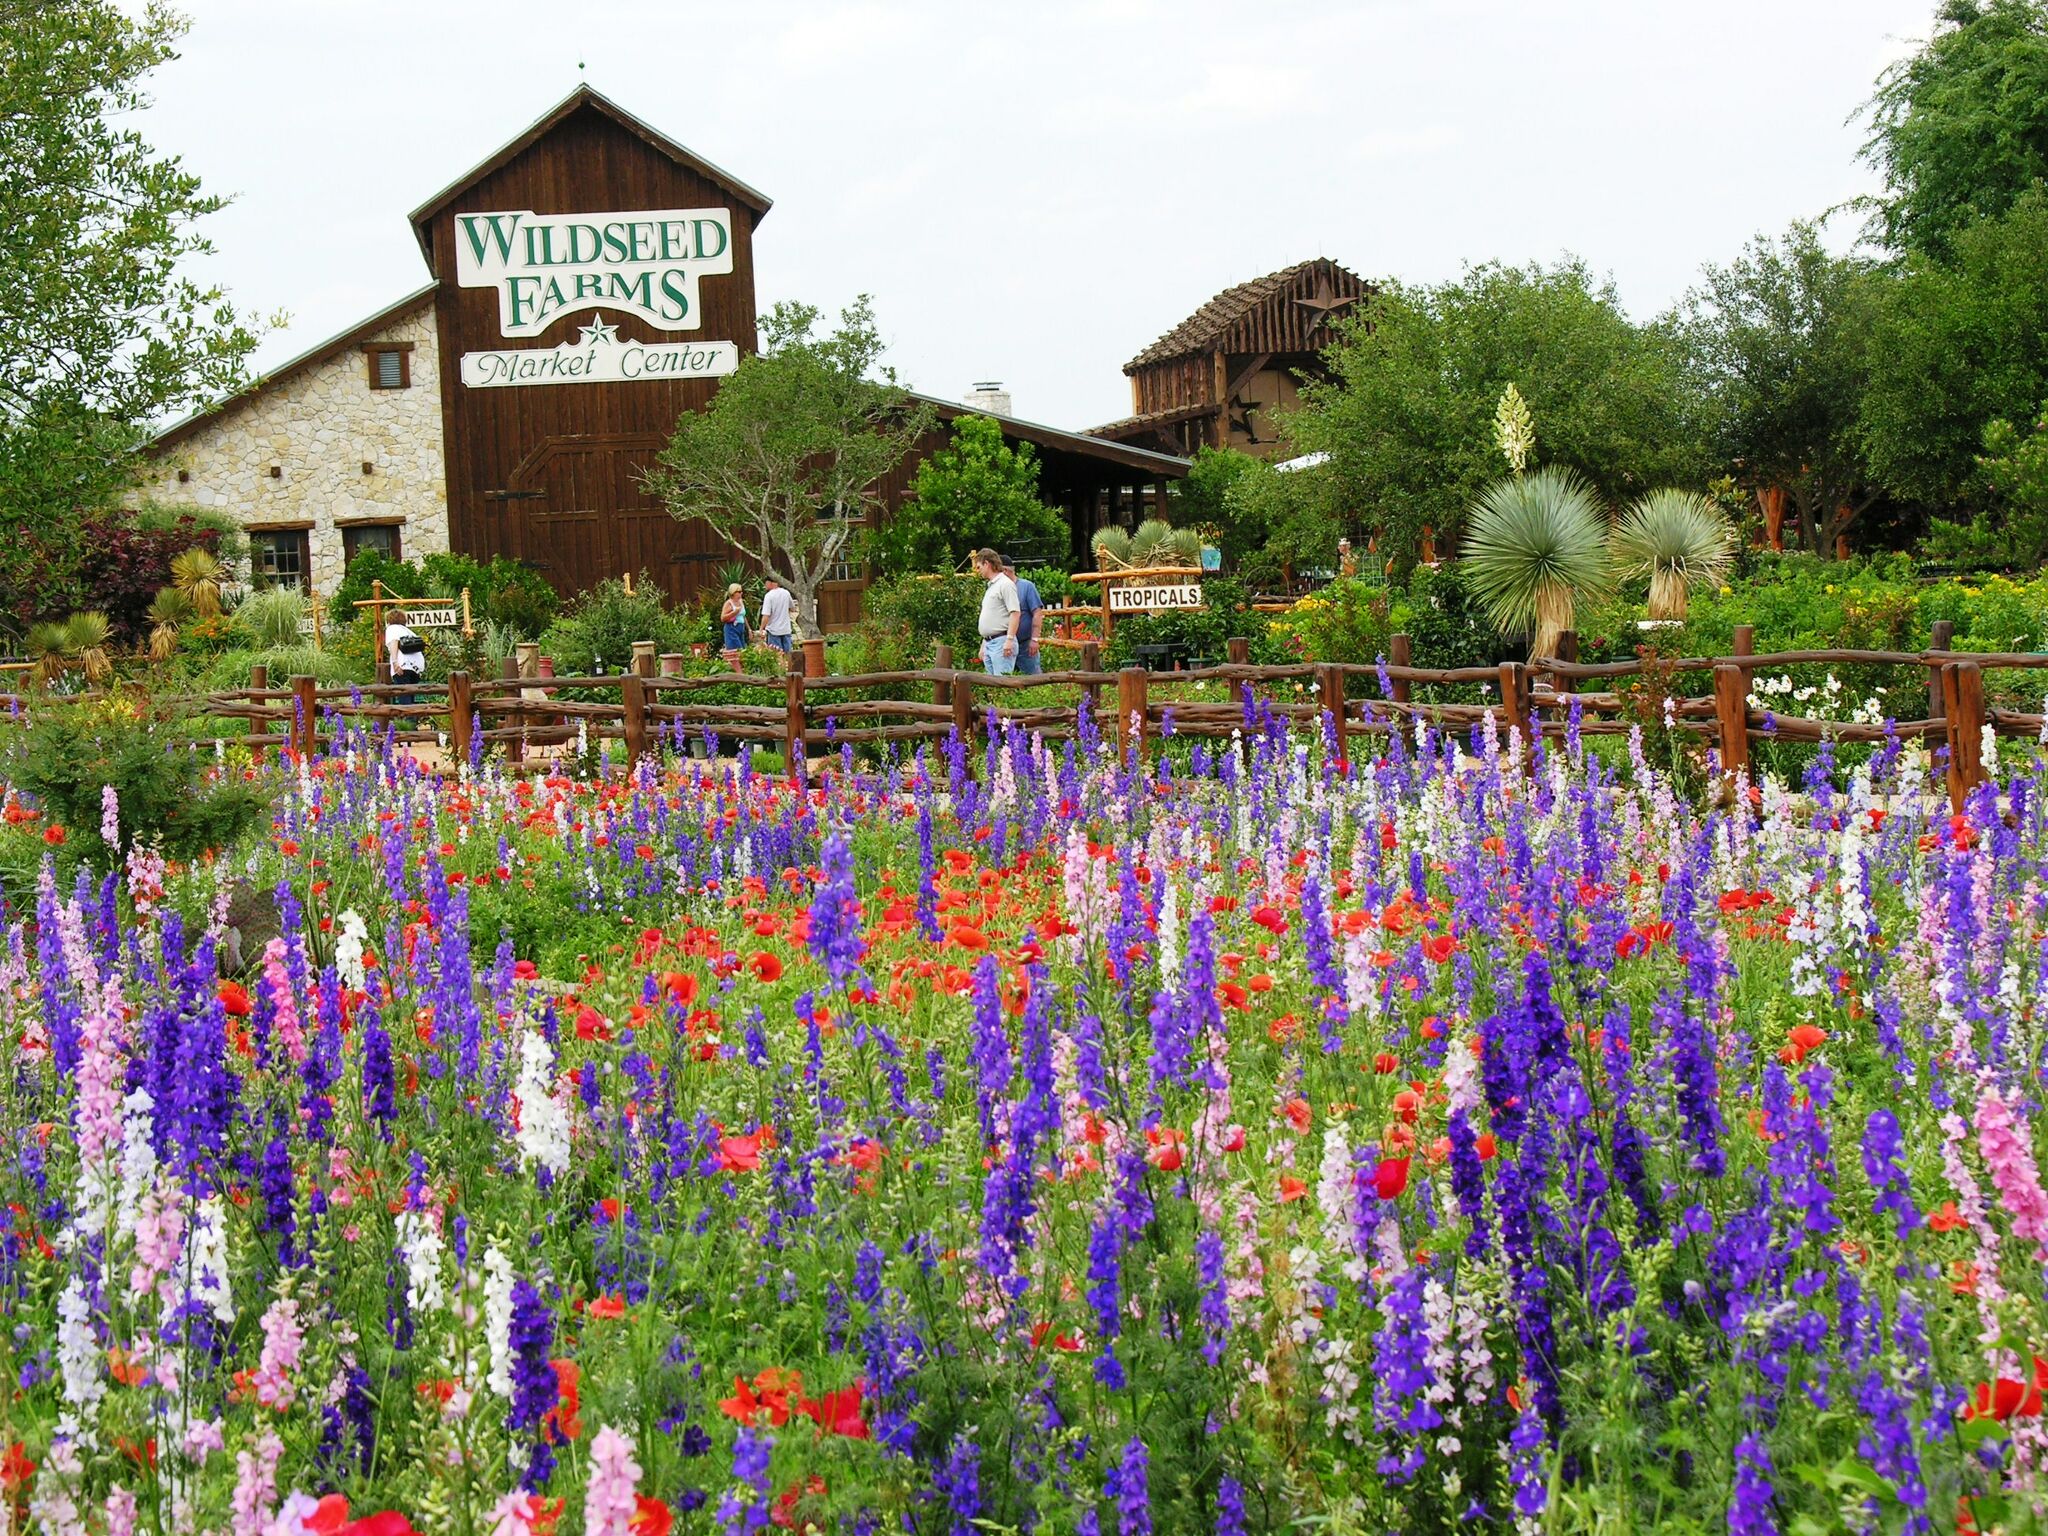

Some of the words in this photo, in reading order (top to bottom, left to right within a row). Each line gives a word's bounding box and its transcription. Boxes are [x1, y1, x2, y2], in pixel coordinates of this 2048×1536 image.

[457, 214, 727, 268] WILDSEED
[505, 269, 688, 328] FARMS
[478, 349, 597, 384] Market
[621, 345, 722, 378] Center
[1112, 588, 1198, 607] TROPICALS
[406, 611, 452, 625] NTANA
